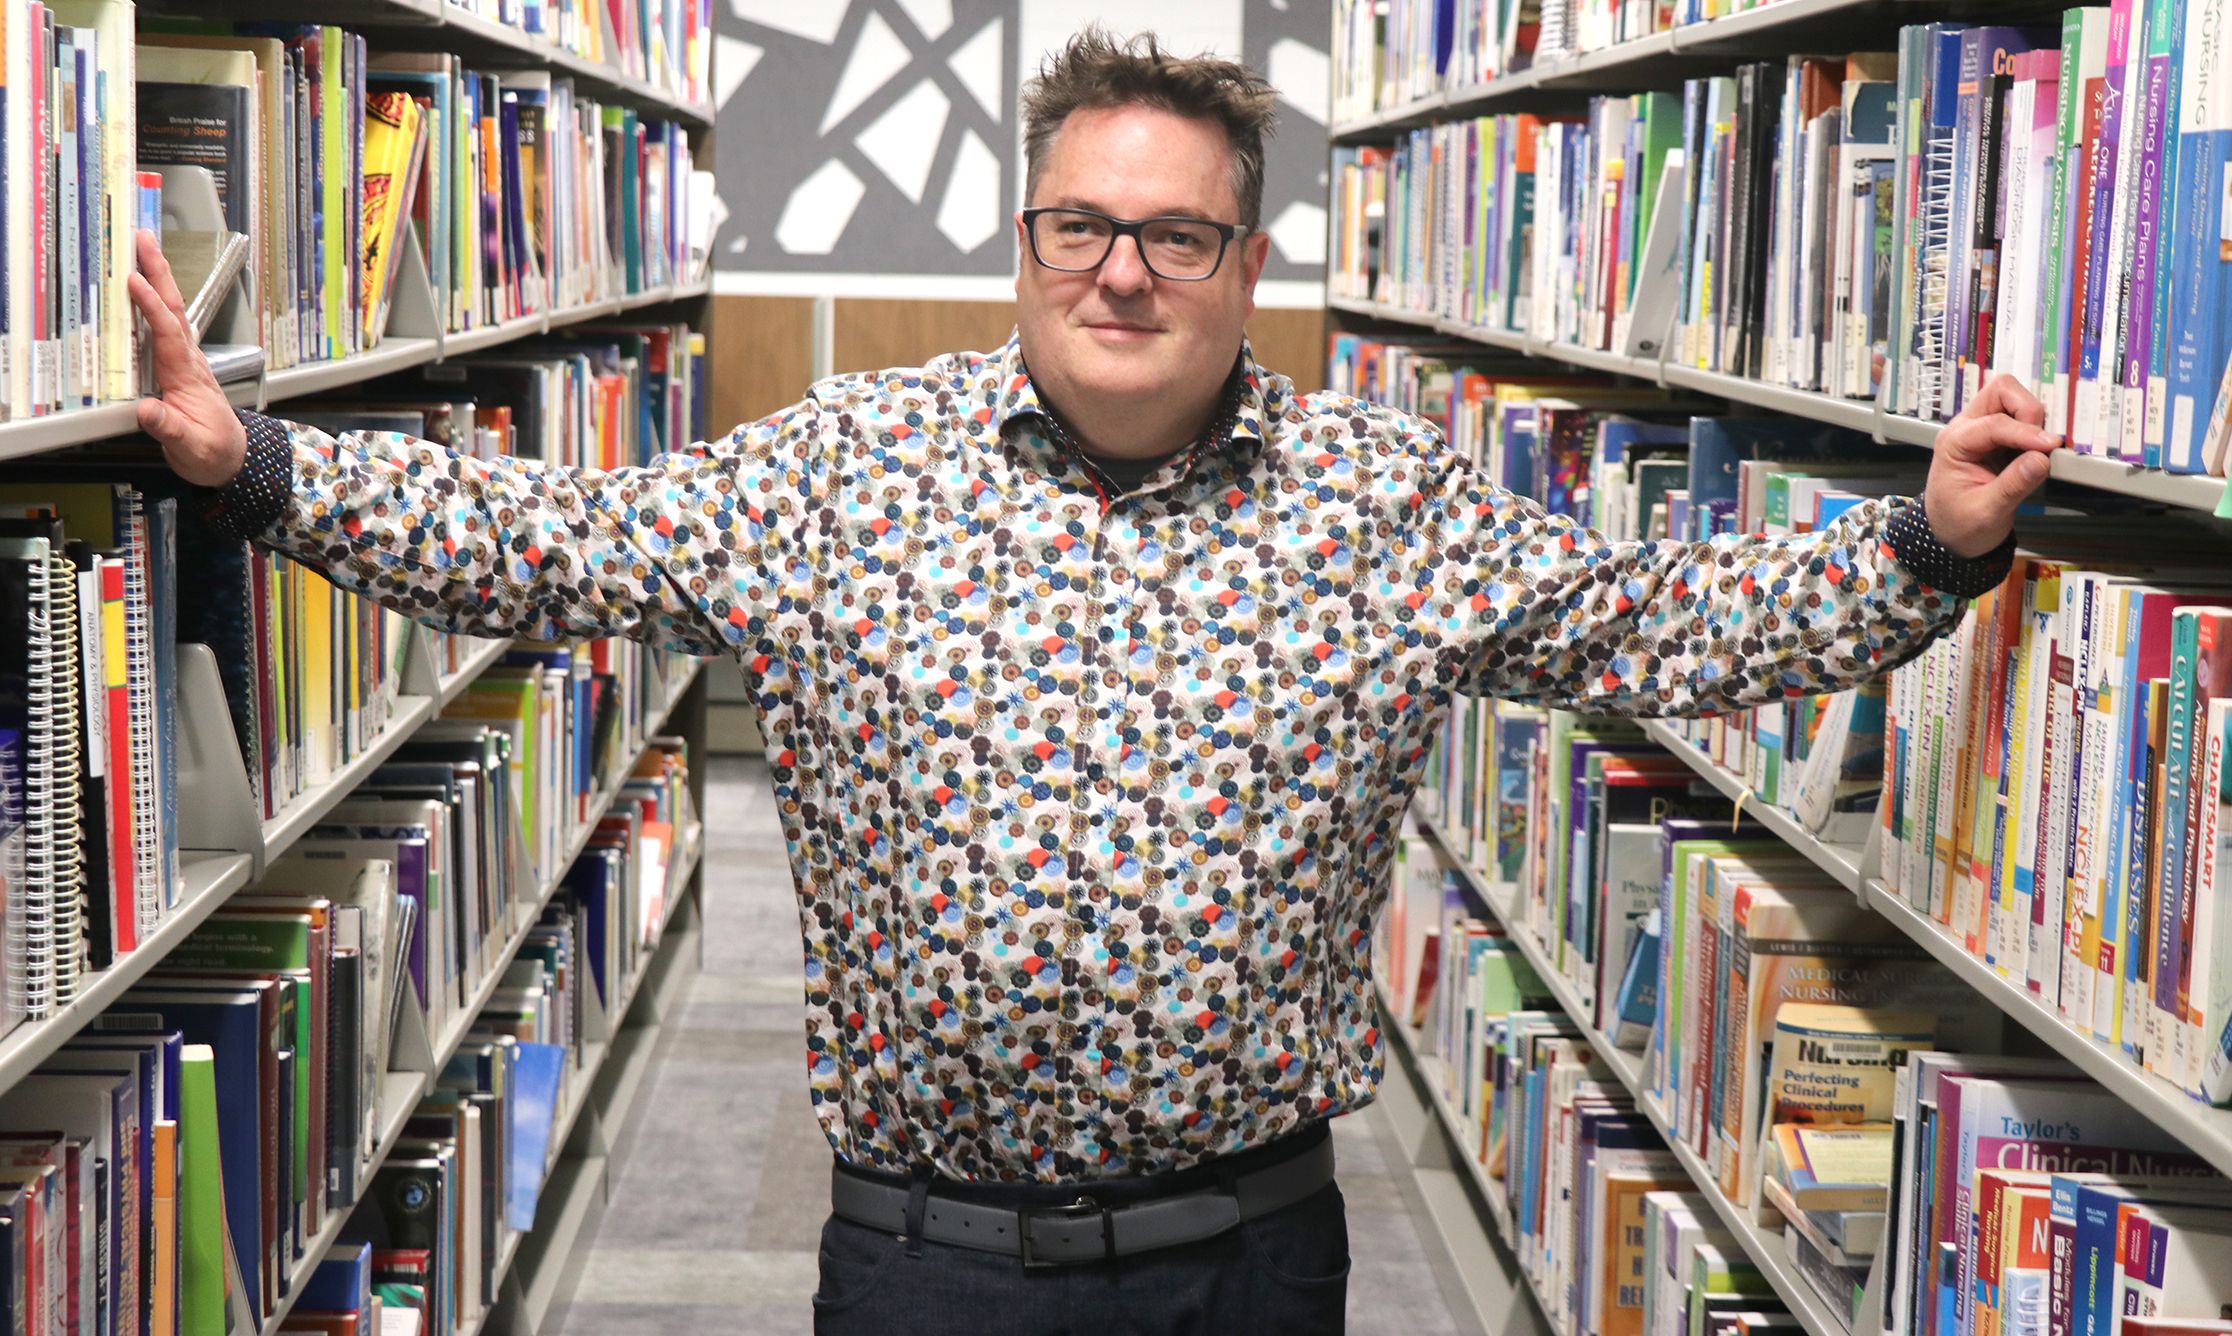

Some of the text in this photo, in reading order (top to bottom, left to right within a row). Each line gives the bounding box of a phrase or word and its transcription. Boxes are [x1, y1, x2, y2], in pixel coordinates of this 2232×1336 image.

[2059, 41, 2072, 137] NURSING
[2146, 65, 2163, 152] Nursing
[193, 117, 216, 126] Praise
[216, 118, 227, 126] for
[193, 126, 227, 138] Sheep
[2136, 94, 2148, 151] Nursing
[2101, 145, 2110, 180] ONE
[2134, 154, 2143, 187] Care
[2143, 159, 2155, 213] Care
[2052, 140, 2067, 249] DIAGNOSIS
[2131, 190, 2140, 228] Plans
[2138, 220, 2152, 282] Plans
[2120, 248, 2136, 354] Documentation
[87, 612, 98, 660] ANATOMY
[90, 672, 102, 737] PHYSIOLOGY
[1923, 655, 1937, 751] NCLEX-RN
[2077, 639, 2090, 712] NCLEX-PN
[2169, 655, 2188, 799] CALCULATE
[2116, 743, 2126, 786] REVIEW
[2111, 794, 2120, 820] FOR
[2182, 700, 2205, 926] Anatomy and Physiology
[2203, 735, 2222, 890] CHARTSMART
[2071, 722, 2094, 958] MASTER THE NCLEX-P
[2128, 779, 2146, 936] DISEASES
[2161, 842, 2177, 967] Confidence
[1779, 984, 1865, 1001] NURSING
[1787, 966, 1871, 983] MEDICAL
[1781, 1097, 1865, 1114] Procedures
[1783, 1068, 1860, 1089] Perfecting
[1783, 1083, 1837, 1100] Clinical
[1961, 1130, 1970, 1181] Taylor's
[2000, 1115, 2081, 1141] Taylor's
[1996, 1142, 2119, 1175] Clinical
[1955, 1189, 1971, 1317] Clinical Nursing
[1983, 1210, 1993, 1254] Nursing
[1989, 1187, 2002, 1279] Medical-Surgical
[2052, 1234, 2067, 1317] Basic
[2063, 1237, 2073, 1331] Modules for
[2089, 1246, 2099, 1308] Lippincott
